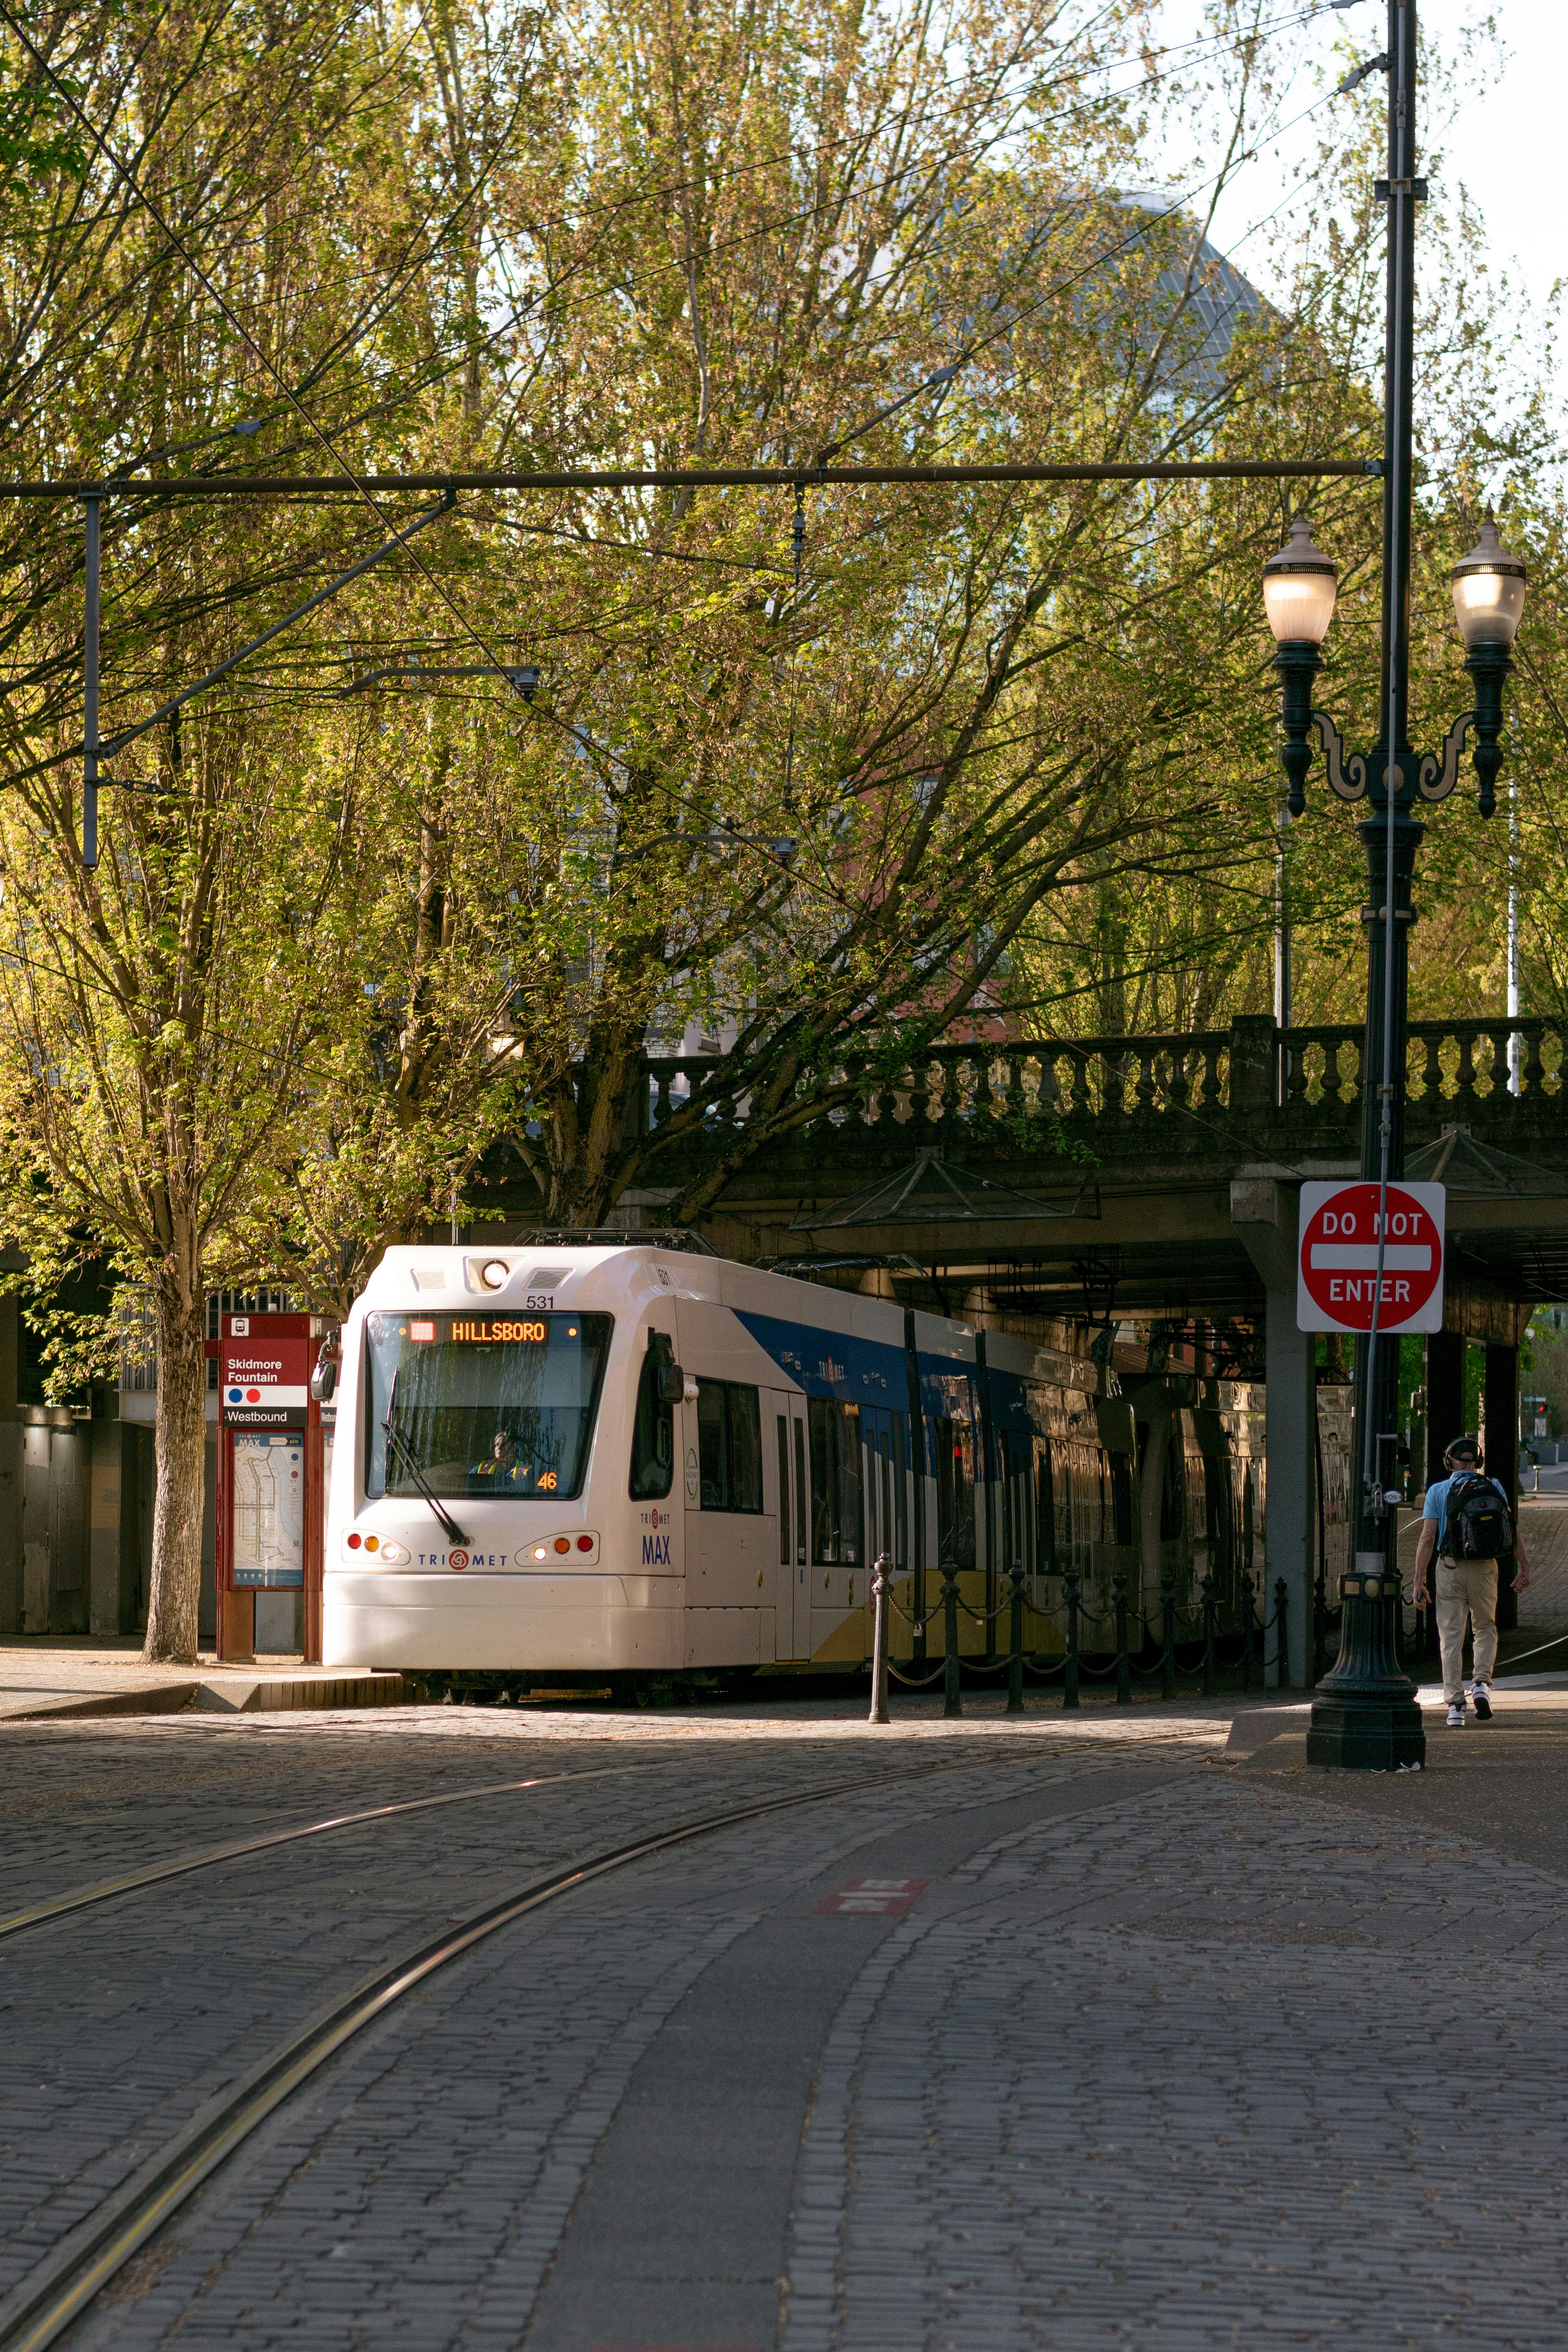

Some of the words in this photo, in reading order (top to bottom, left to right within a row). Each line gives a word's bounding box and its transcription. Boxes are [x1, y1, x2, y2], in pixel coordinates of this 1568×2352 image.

[1323, 1212, 1356, 1235] DO
[1374, 1213, 1423, 1235] NOT
[658, 1269, 671, 1286] 531
[1330, 1279, 1410, 1302] ENTER
[526, 1296, 554, 1309] 531
[452, 1322, 544, 1341] HILLSBORO
[228, 1359, 282, 1369] Skidmore
[228, 1372, 278, 1382] Fountain
[228, 1412, 287, 1421] Westbound
[537, 1471, 557, 1490] 46
[642, 1535, 670, 1565] MAX
